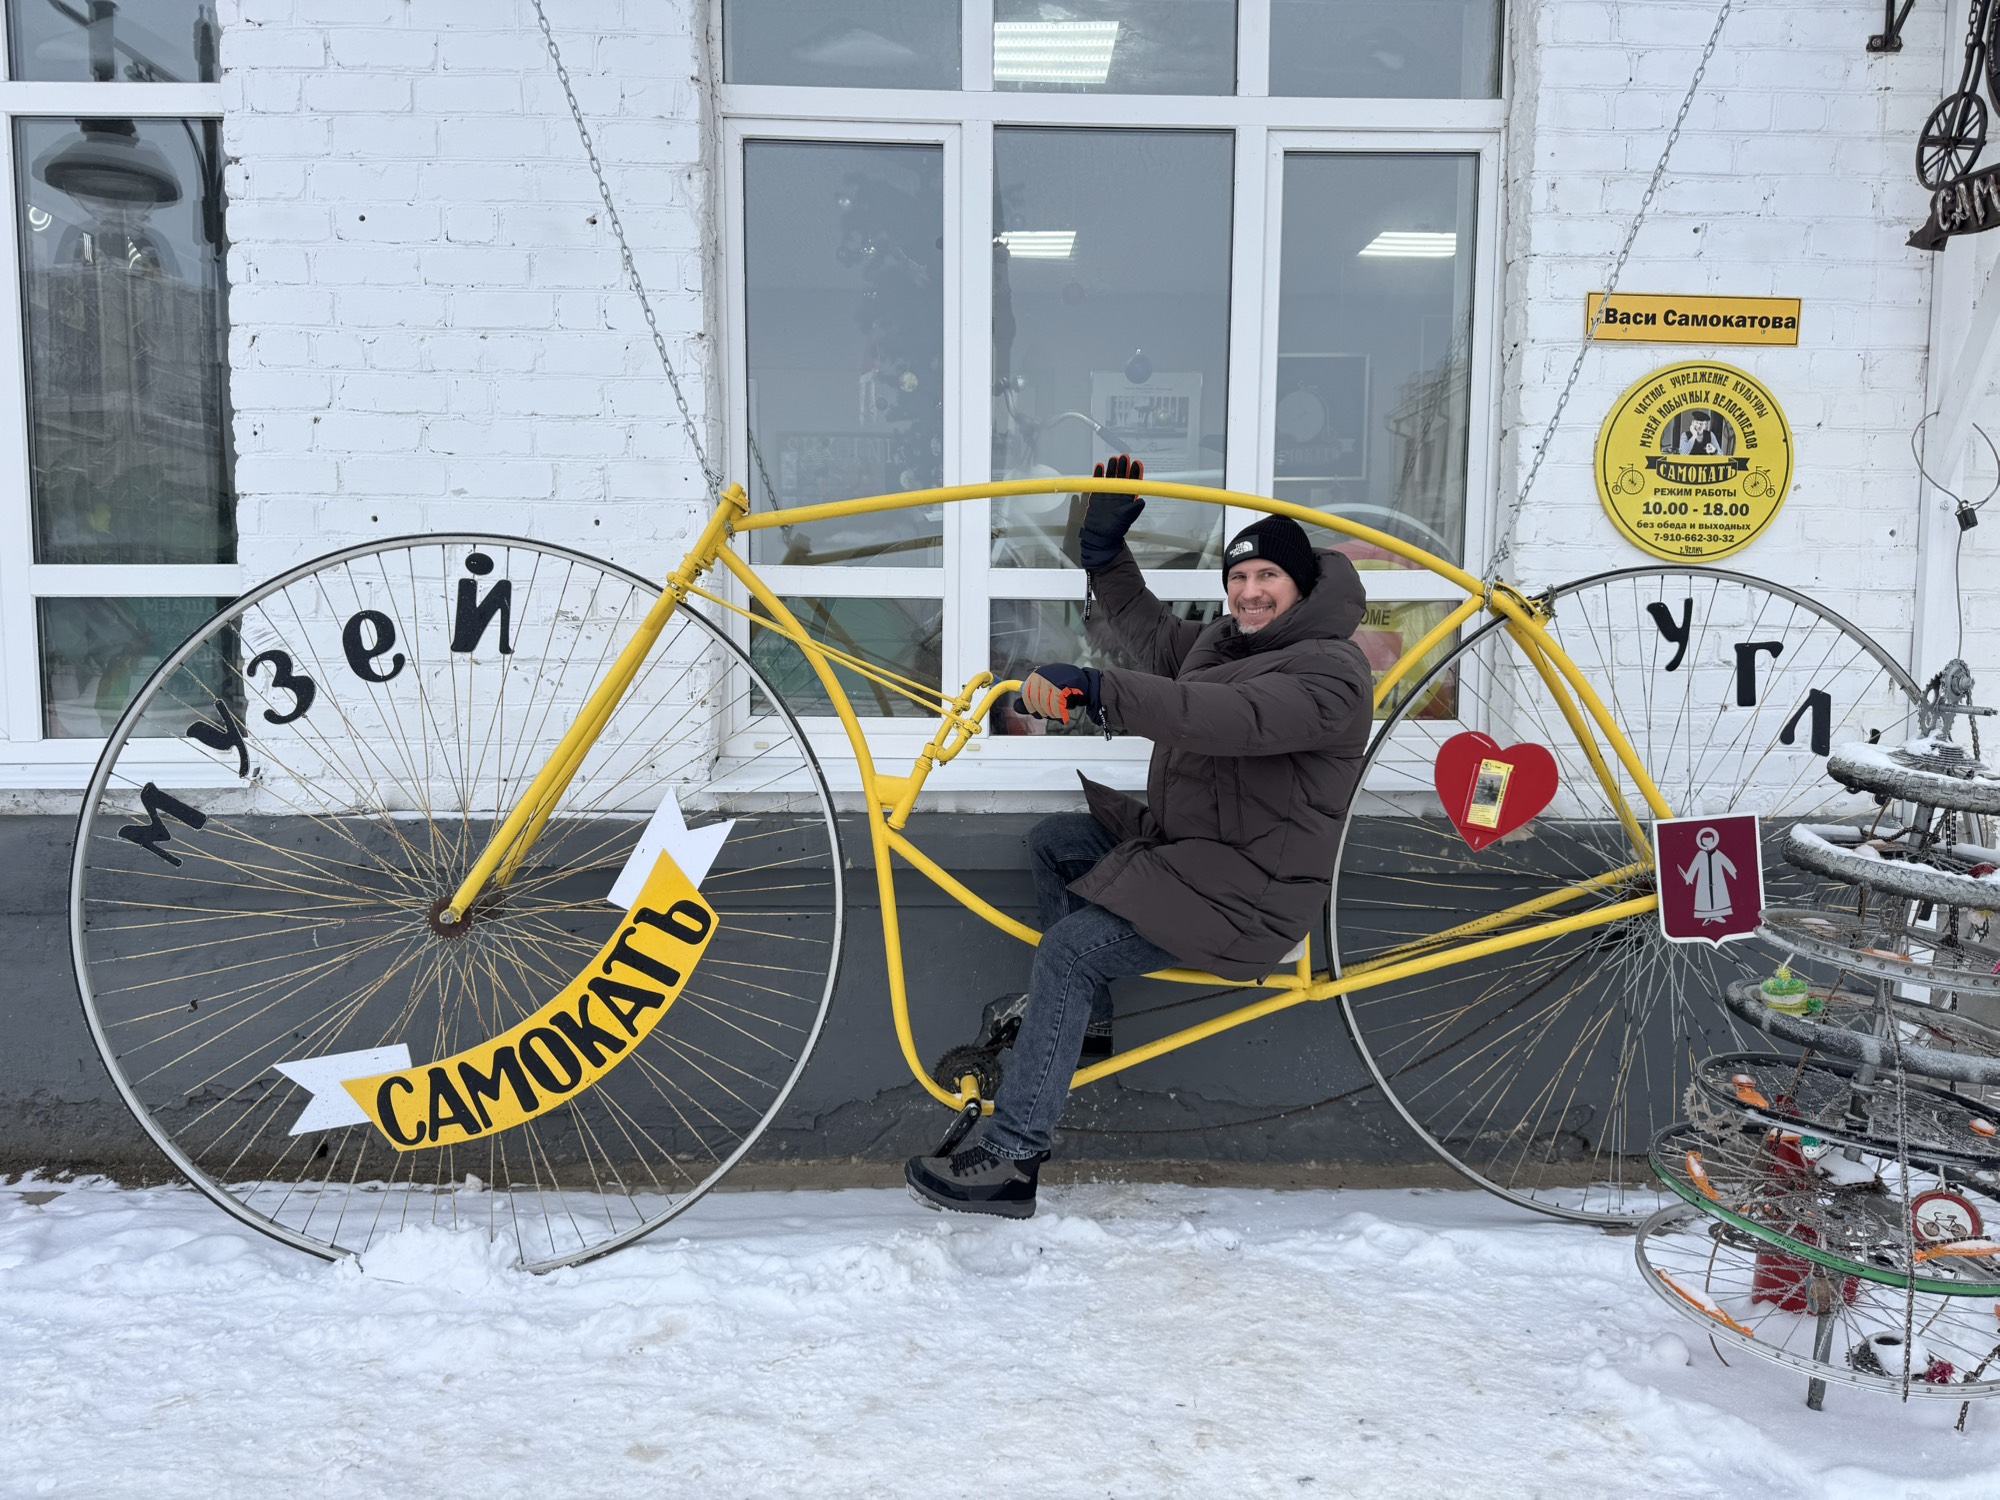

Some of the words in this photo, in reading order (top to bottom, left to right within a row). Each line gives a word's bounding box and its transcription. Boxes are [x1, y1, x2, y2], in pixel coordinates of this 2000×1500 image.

[1605, 308, 1657, 325] Васи
[1663, 309, 1796, 329] Самокатова
[1634, 384, 1666, 415] ЧАСТНОЕ
[1732, 380, 1769, 419] КУЛЬТУРЫ
[1640, 415, 1661, 448] МУЗЕЙ
[1712, 393, 1758, 450] ВЕЛОСИПЕДОВ
[1659, 463, 1737, 483] САМОКАТЪ
[1653, 487, 1692, 497] РЕЖИМ
[1695, 488, 1737, 498] РАБОТЫ
[1642, 501, 1689, 515] 10.00
[1702, 502, 1750, 516] 18.00
[1636, 520, 1655, 529] без
[1657, 521, 1687, 530] обеда
[1698, 523, 1751, 531] выходных
[1653, 533, 1735, 543] 7-910-662-30-32
[377, 899, 713, 1147] САМОКАТЪ
